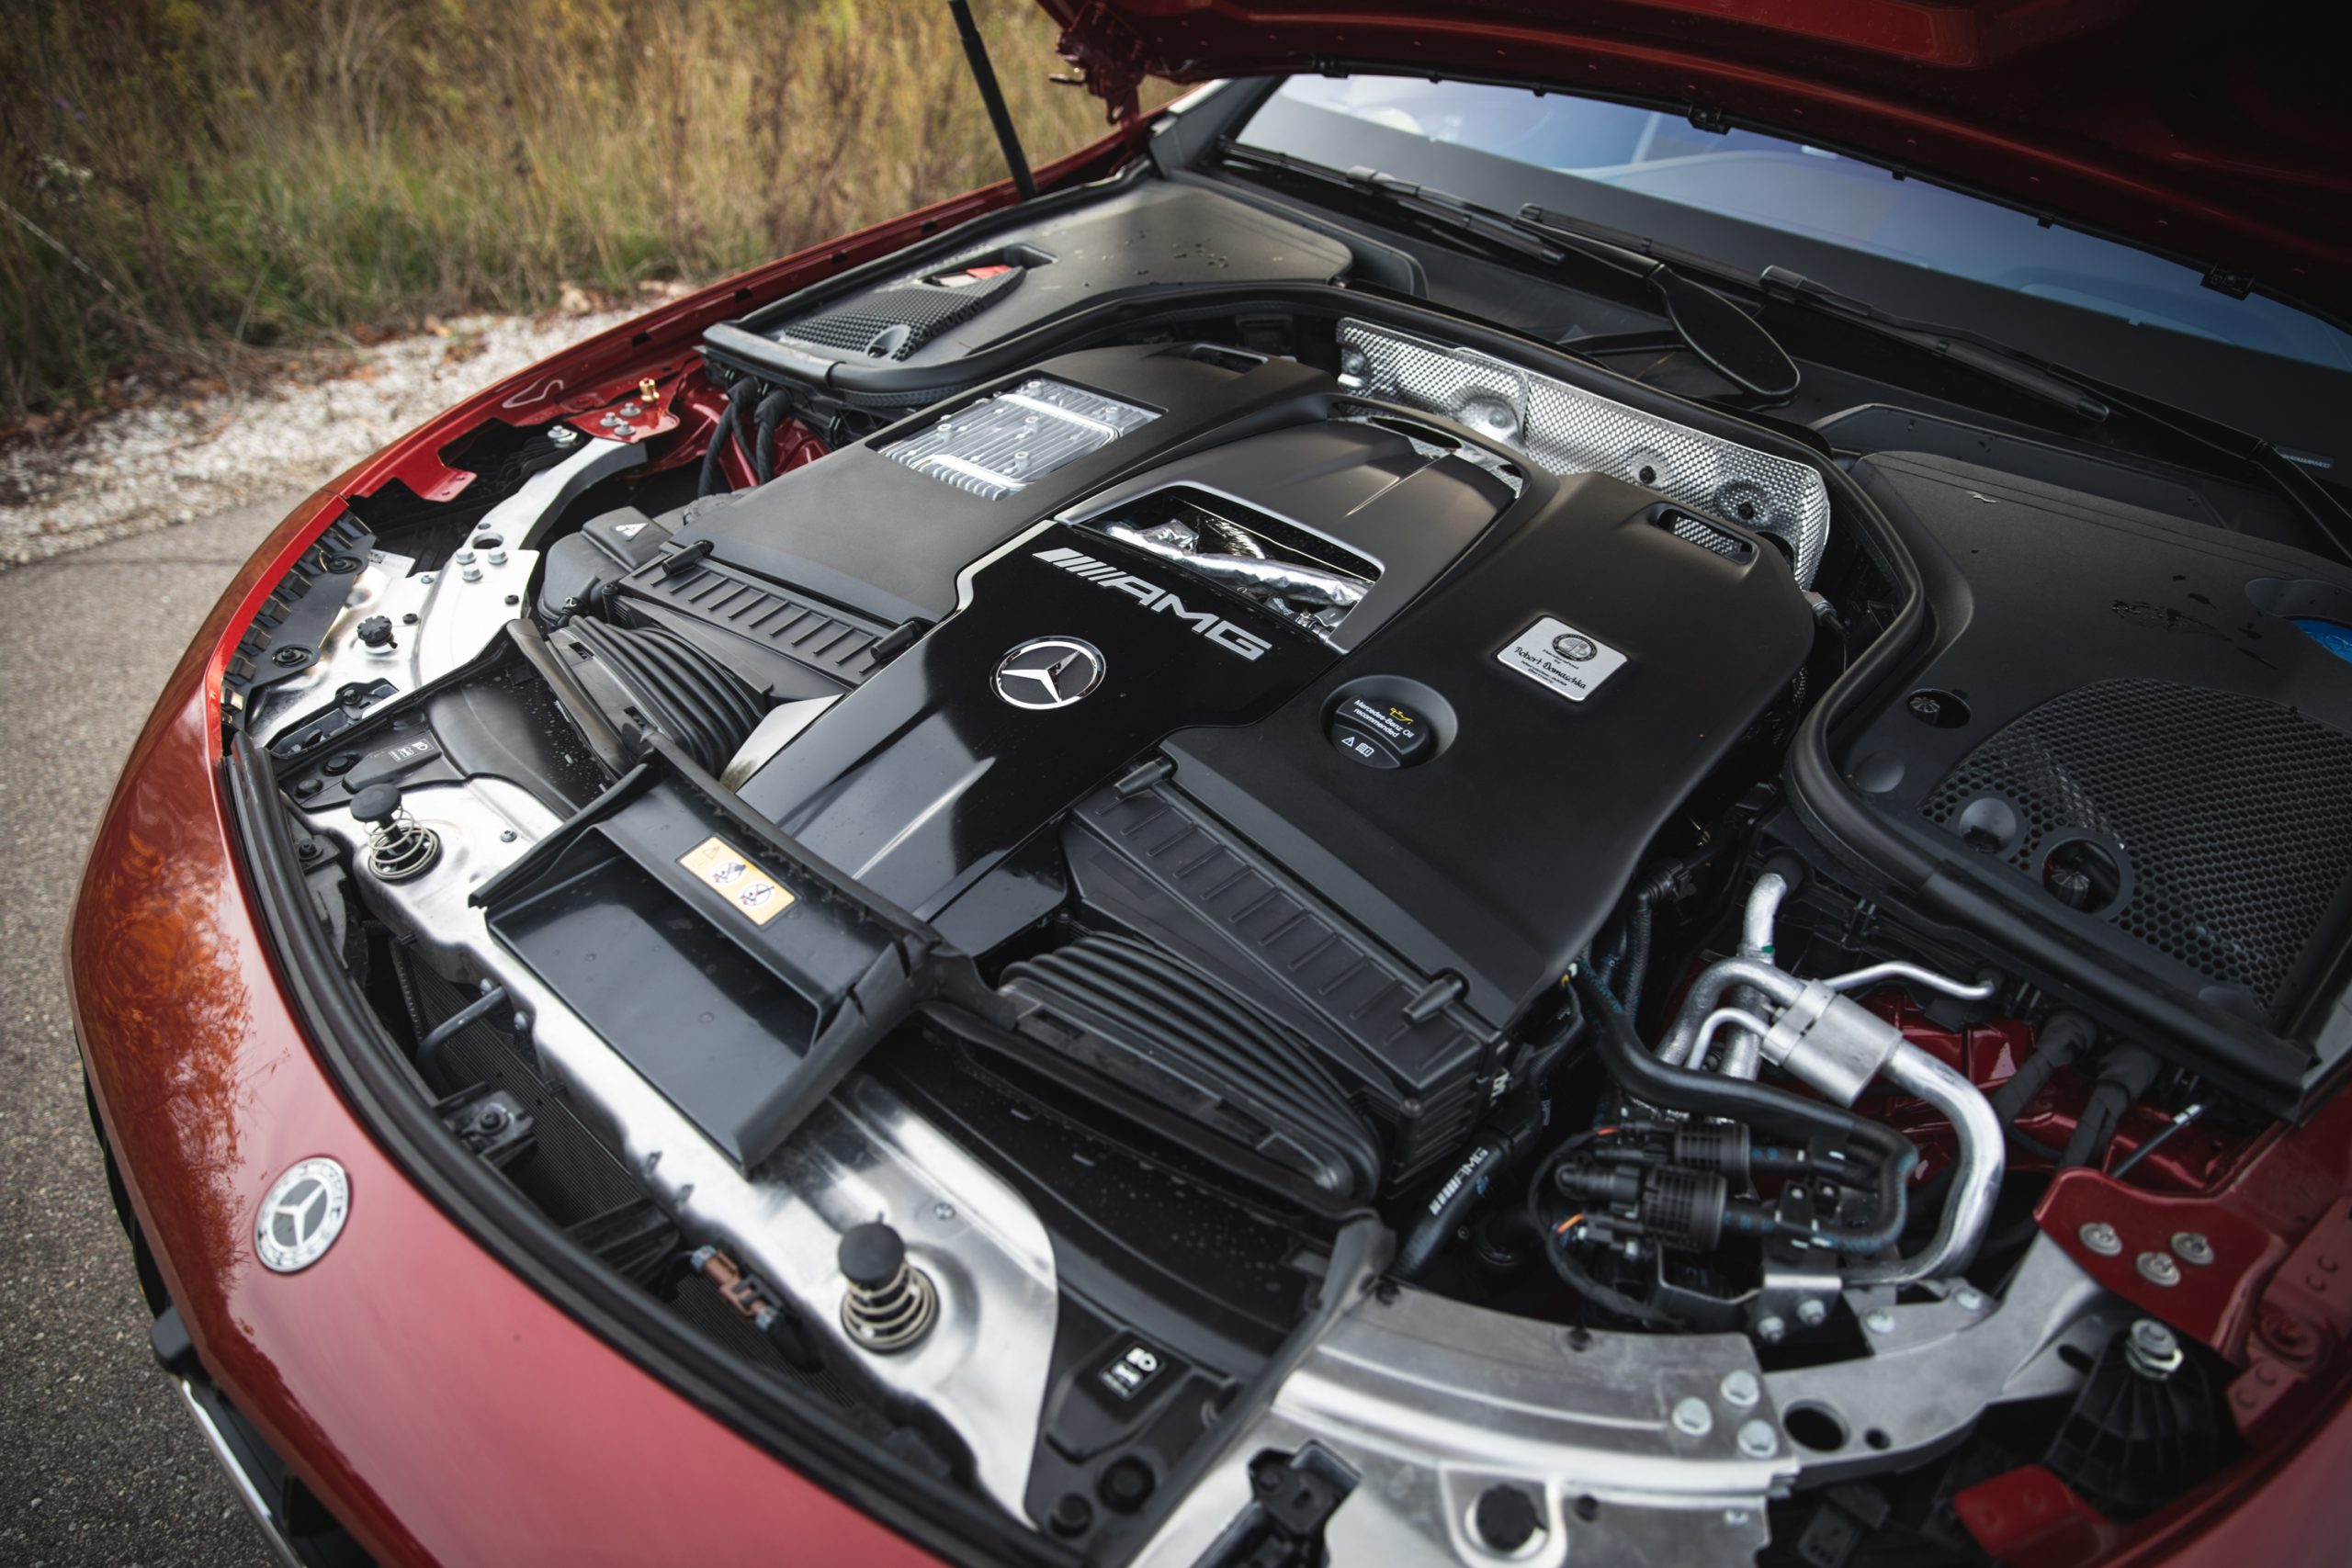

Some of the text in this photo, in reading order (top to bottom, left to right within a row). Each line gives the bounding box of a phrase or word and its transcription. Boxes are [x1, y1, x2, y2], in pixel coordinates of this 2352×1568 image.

[1515, 647, 1542, 665] Robert
[1543, 662, 1587, 689] Domaschka
[1353, 708, 1400, 738] recommended
[1354, 700, 1415, 739] Mercedes-Benz Oil
